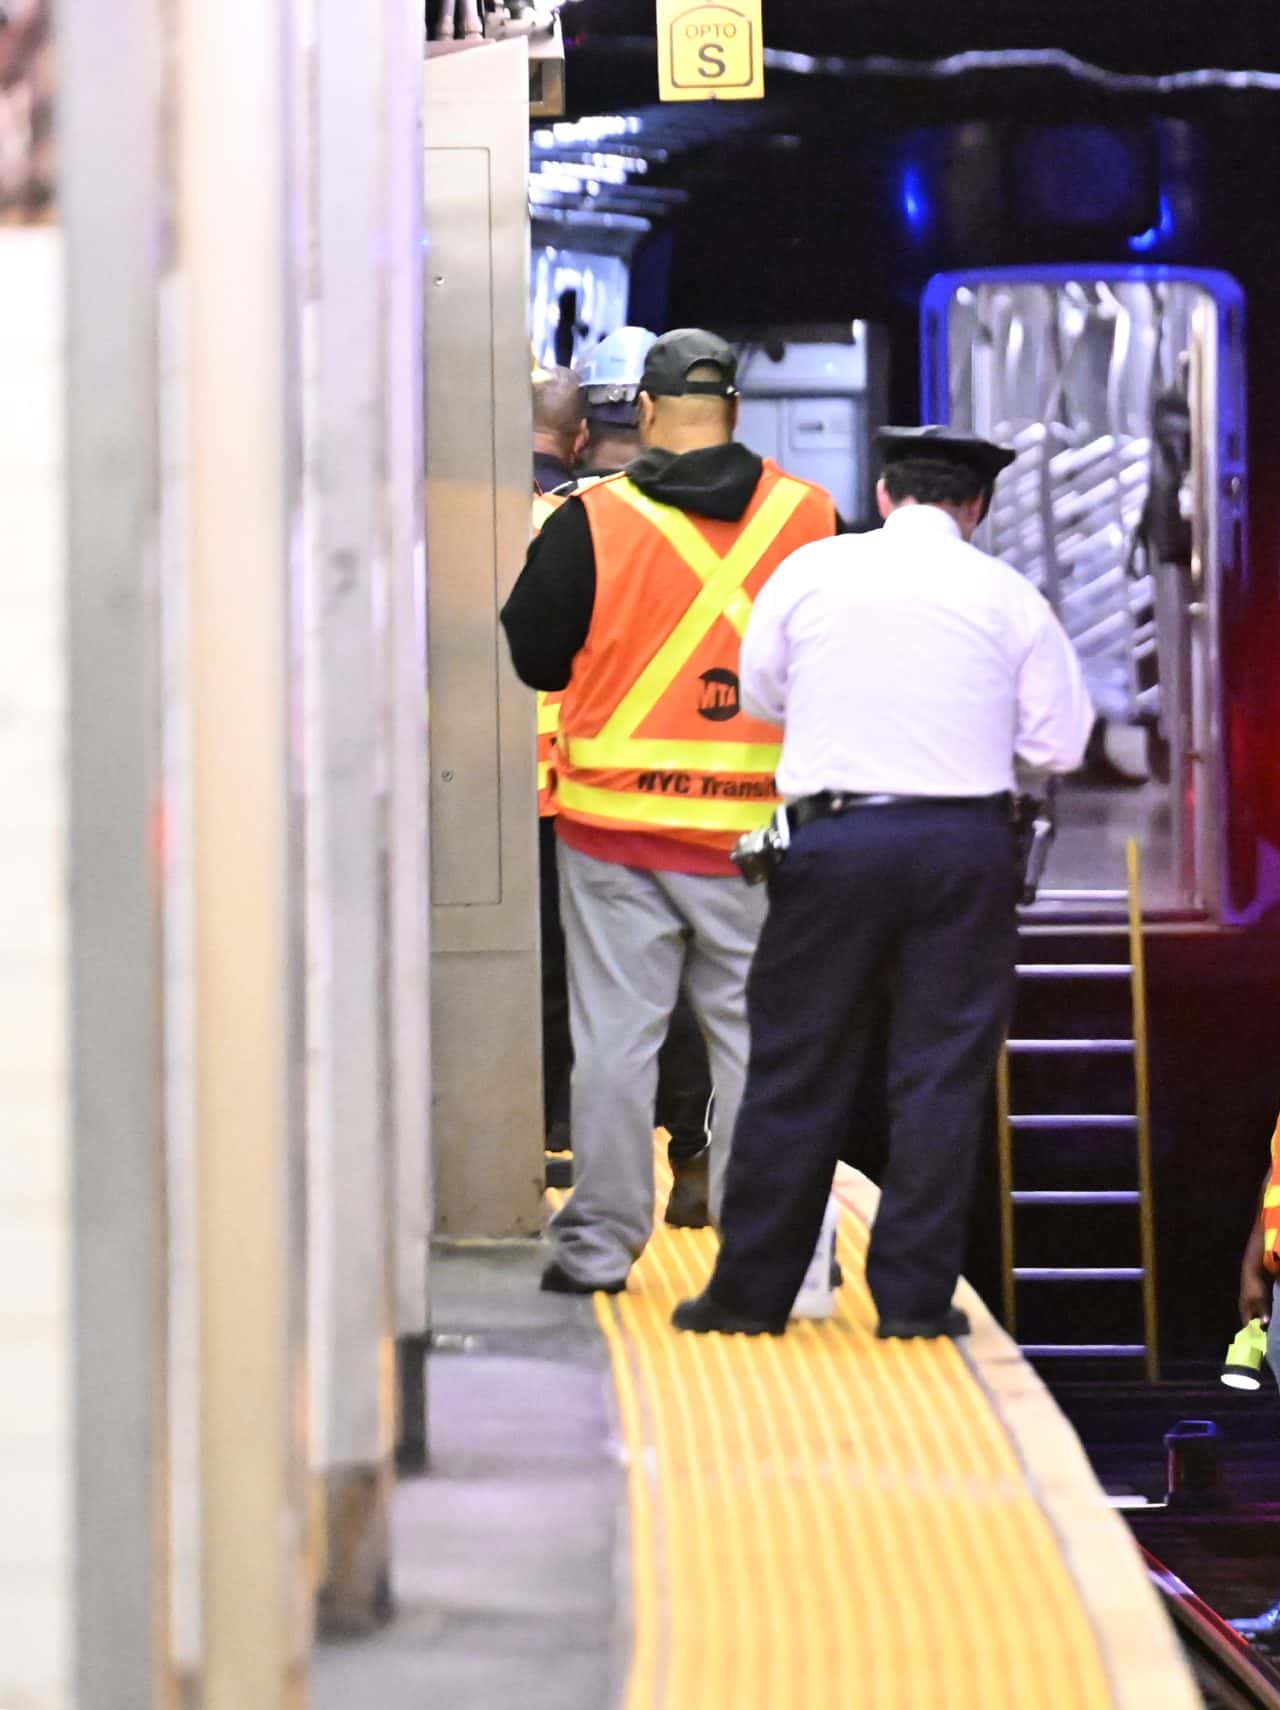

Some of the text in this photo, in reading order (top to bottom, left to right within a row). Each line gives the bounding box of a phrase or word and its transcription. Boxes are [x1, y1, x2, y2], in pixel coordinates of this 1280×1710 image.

[686, 23, 736, 39] OPTO
[698, 43, 726, 78] S
[637, 770, 690, 794] NYC
